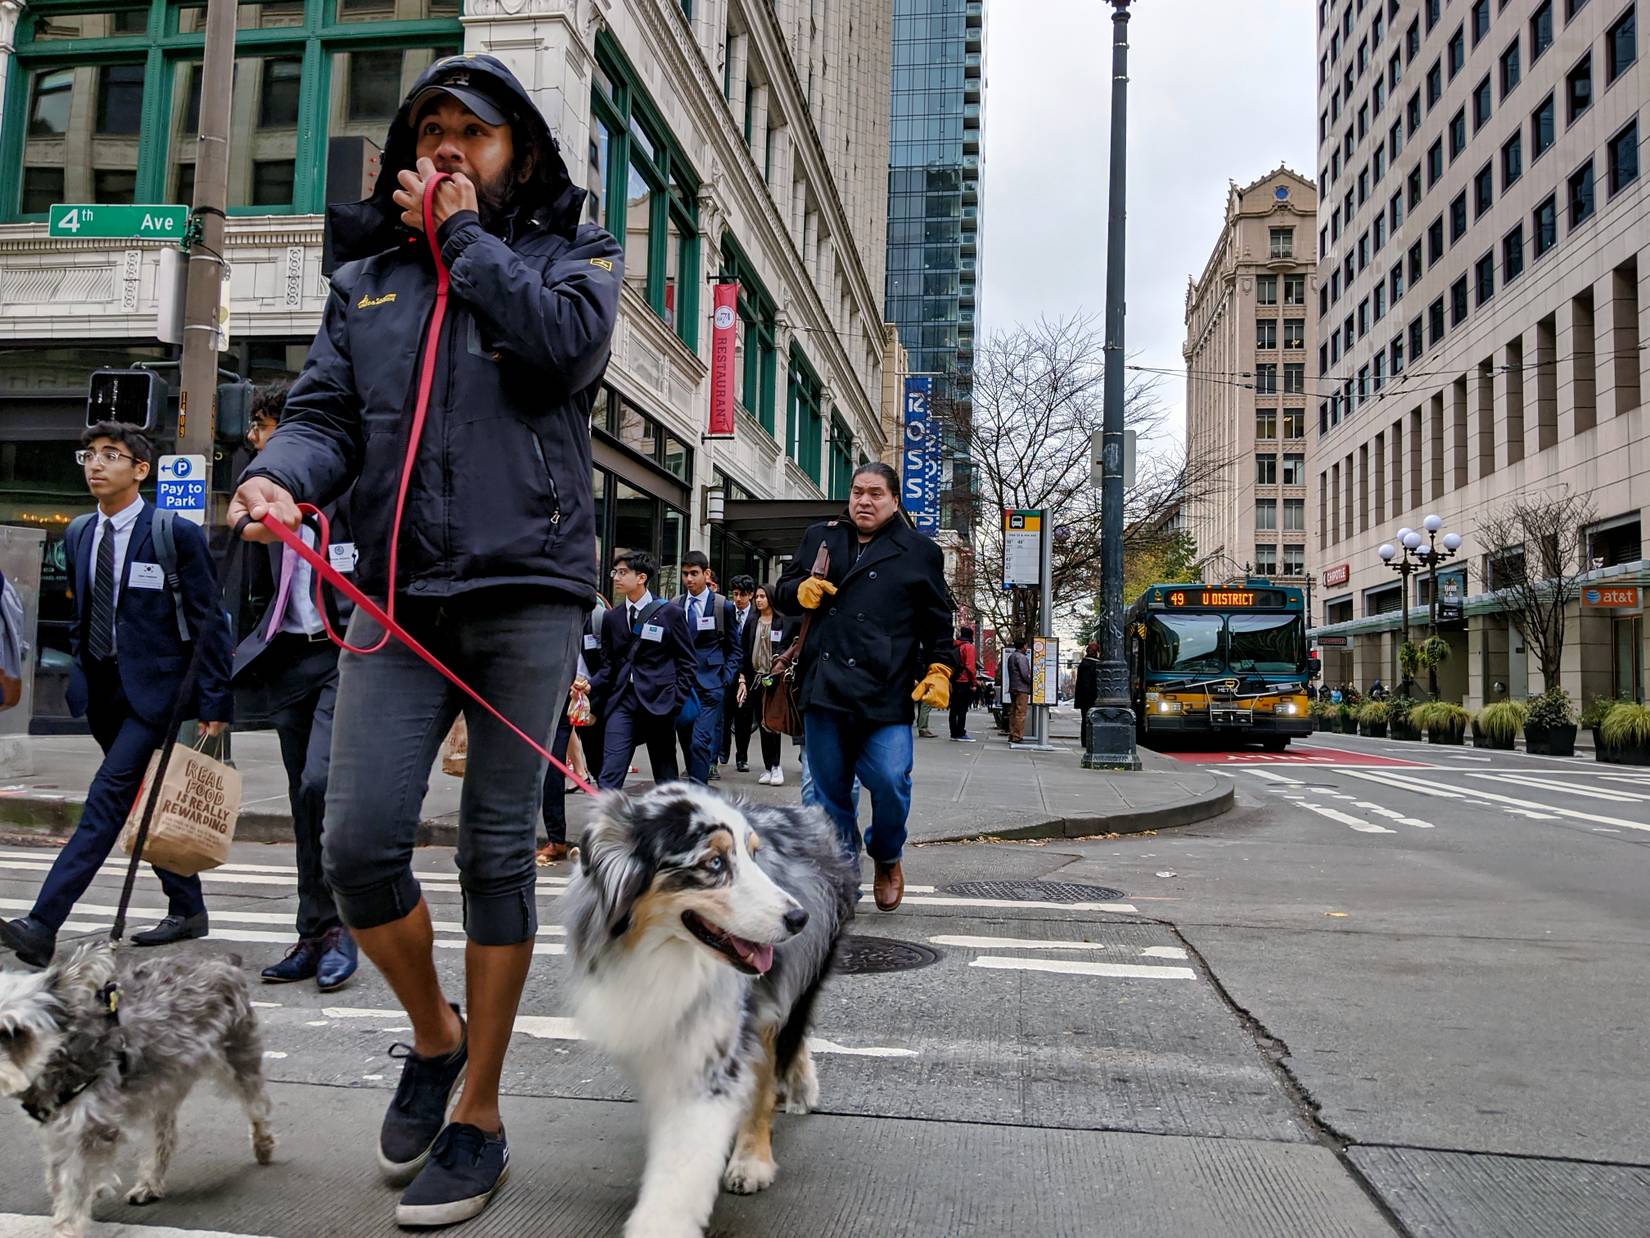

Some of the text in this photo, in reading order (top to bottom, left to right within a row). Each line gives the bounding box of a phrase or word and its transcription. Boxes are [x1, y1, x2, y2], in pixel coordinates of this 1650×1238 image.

[58, 208, 174, 233] 4th Ave
[716, 337, 728, 425] RESTAURANT
[906, 392, 926, 499] ROSS
[177, 465, 188, 475] P
[160, 483, 203, 496] Pay to
[166, 495, 196, 507] Park
[1171, 592, 1254, 606] 49 U DISTRICT
[1603, 590, 1633, 604] at&t
[185, 759, 224, 790] REAL
[185, 779, 225, 806] FOOD
[162, 799, 228, 834] REWARDING
[176, 791, 230, 821] IS REALLY
